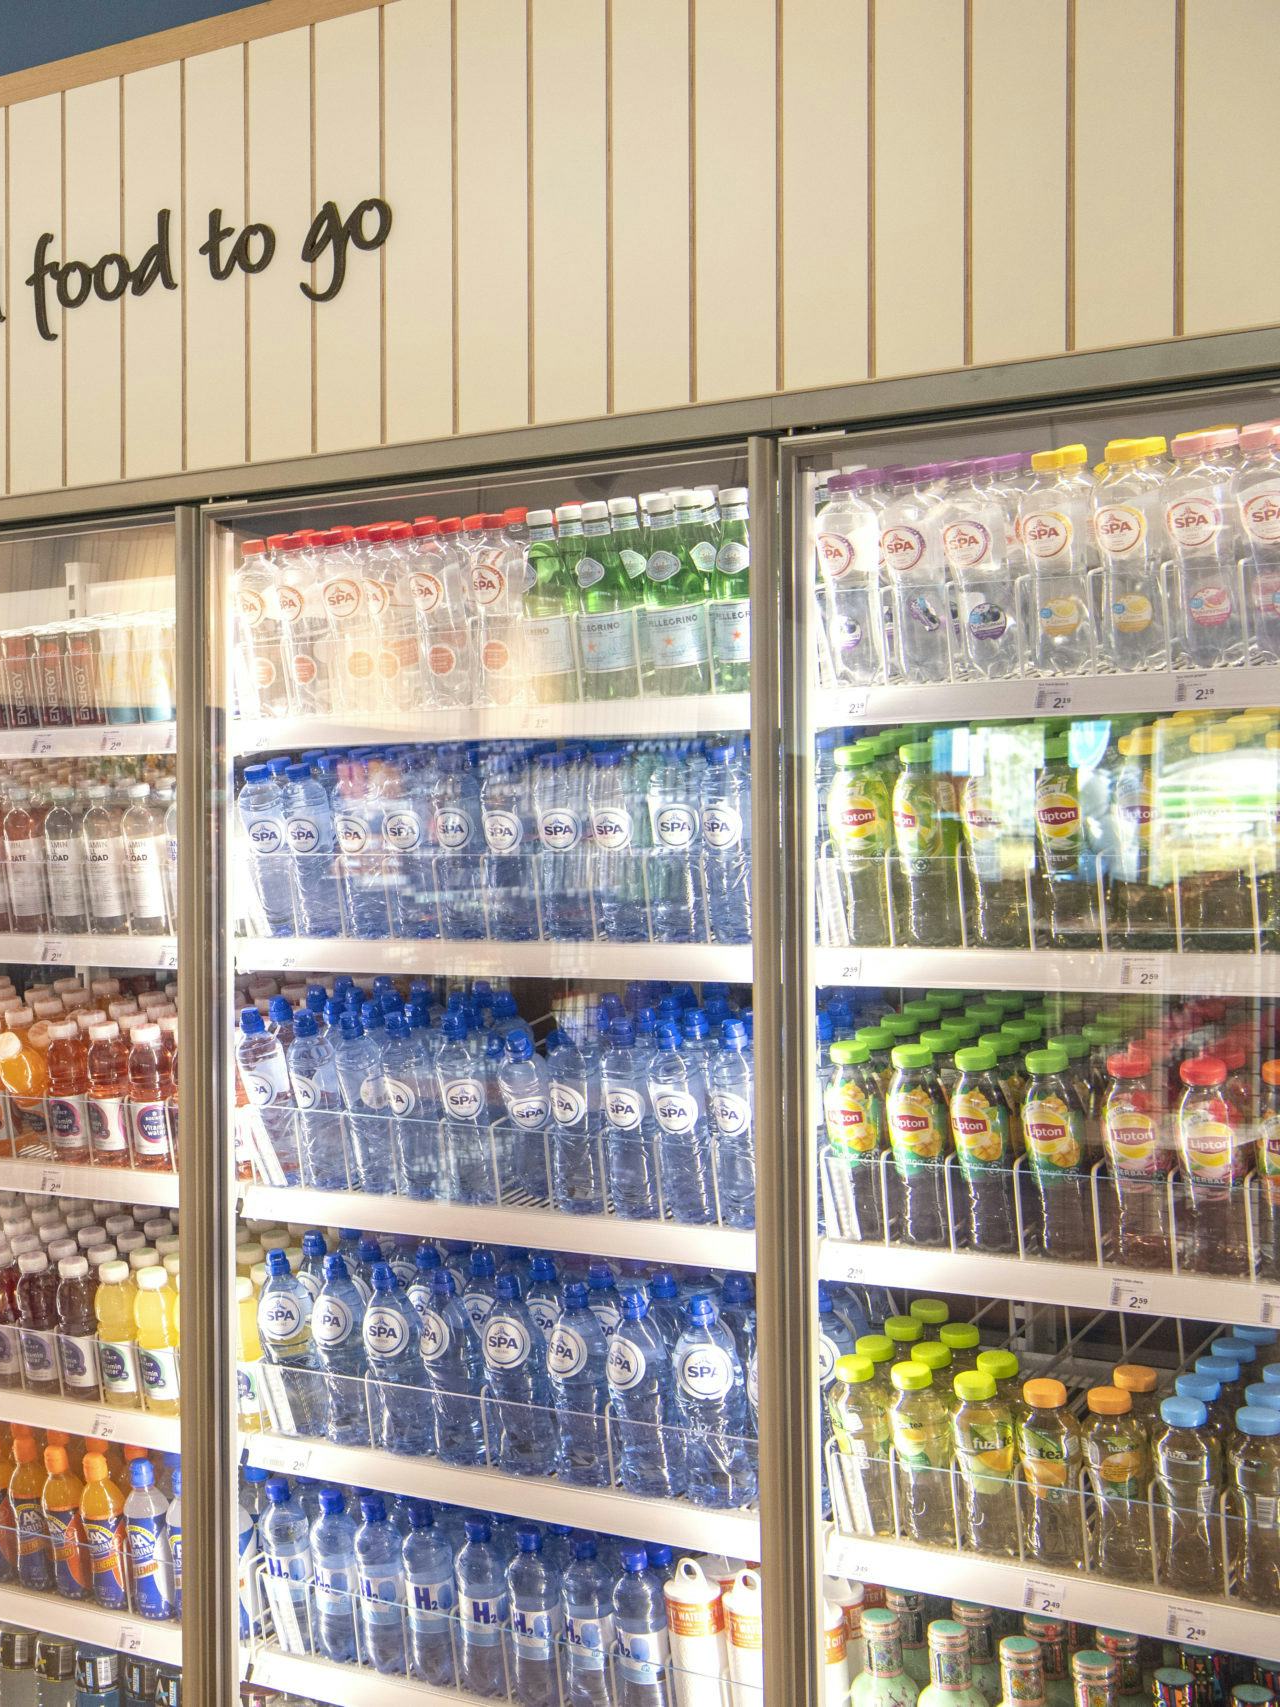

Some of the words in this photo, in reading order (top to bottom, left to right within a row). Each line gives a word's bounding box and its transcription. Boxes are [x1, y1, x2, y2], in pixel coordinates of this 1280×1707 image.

[25, 207, 178, 342] food
[198, 207, 277, 282] to
[298, 196, 394, 303] go
[1100, 520, 1133, 534] SPA
[1174, 514, 1209, 529] SPA
[1028, 526, 1060, 540] SPA
[886, 541, 915, 554] SPA
[326, 592, 355, 606] SPA
[241, 601, 258, 613] PA
[11, 672, 28, 726] ENERGY
[44, 667, 61, 722] ENERGY
[74, 666, 90, 721] ENERGY
[1195, 688, 1215, 701] 2.19
[1039, 809, 1076, 823] Lipton
[389, 826, 416, 837] SPA
[439, 824, 465, 835] SPA
[544, 825, 574, 836] SPA
[595, 824, 623, 835] SPA
[660, 821, 691, 833] SPA
[703, 821, 730, 833] SPA
[252, 831, 279, 842] SPA
[290, 830, 315, 841] SPA
[449, 1095, 477, 1106] SPA
[515, 1107, 544, 1119] SPA
[609, 1103, 635, 1116] SPA
[658, 1107, 688, 1119] SPA
[1114, 1130, 1154, 1142] Lipton
[1190, 1139, 1229, 1151] Lipton
[1128, 1296, 1149, 1309] 2.59
[267, 1309, 296, 1323] SPA
[321, 1316, 342, 1329] PA
[368, 1325, 398, 1340] SPA
[488, 1335, 519, 1350] SPA
[609, 1355, 632, 1373] SPA
[1039, 1447, 1064, 1460] tea
[23, 1510, 40, 1524] AA
[90, 1530, 105, 1543] AA
[131, 1534, 149, 1546] AA
[137, 1563, 158, 1576] LEMON
[1041, 1599, 1061, 1613] 2.49
[1186, 1627, 1207, 1641] 2.49
